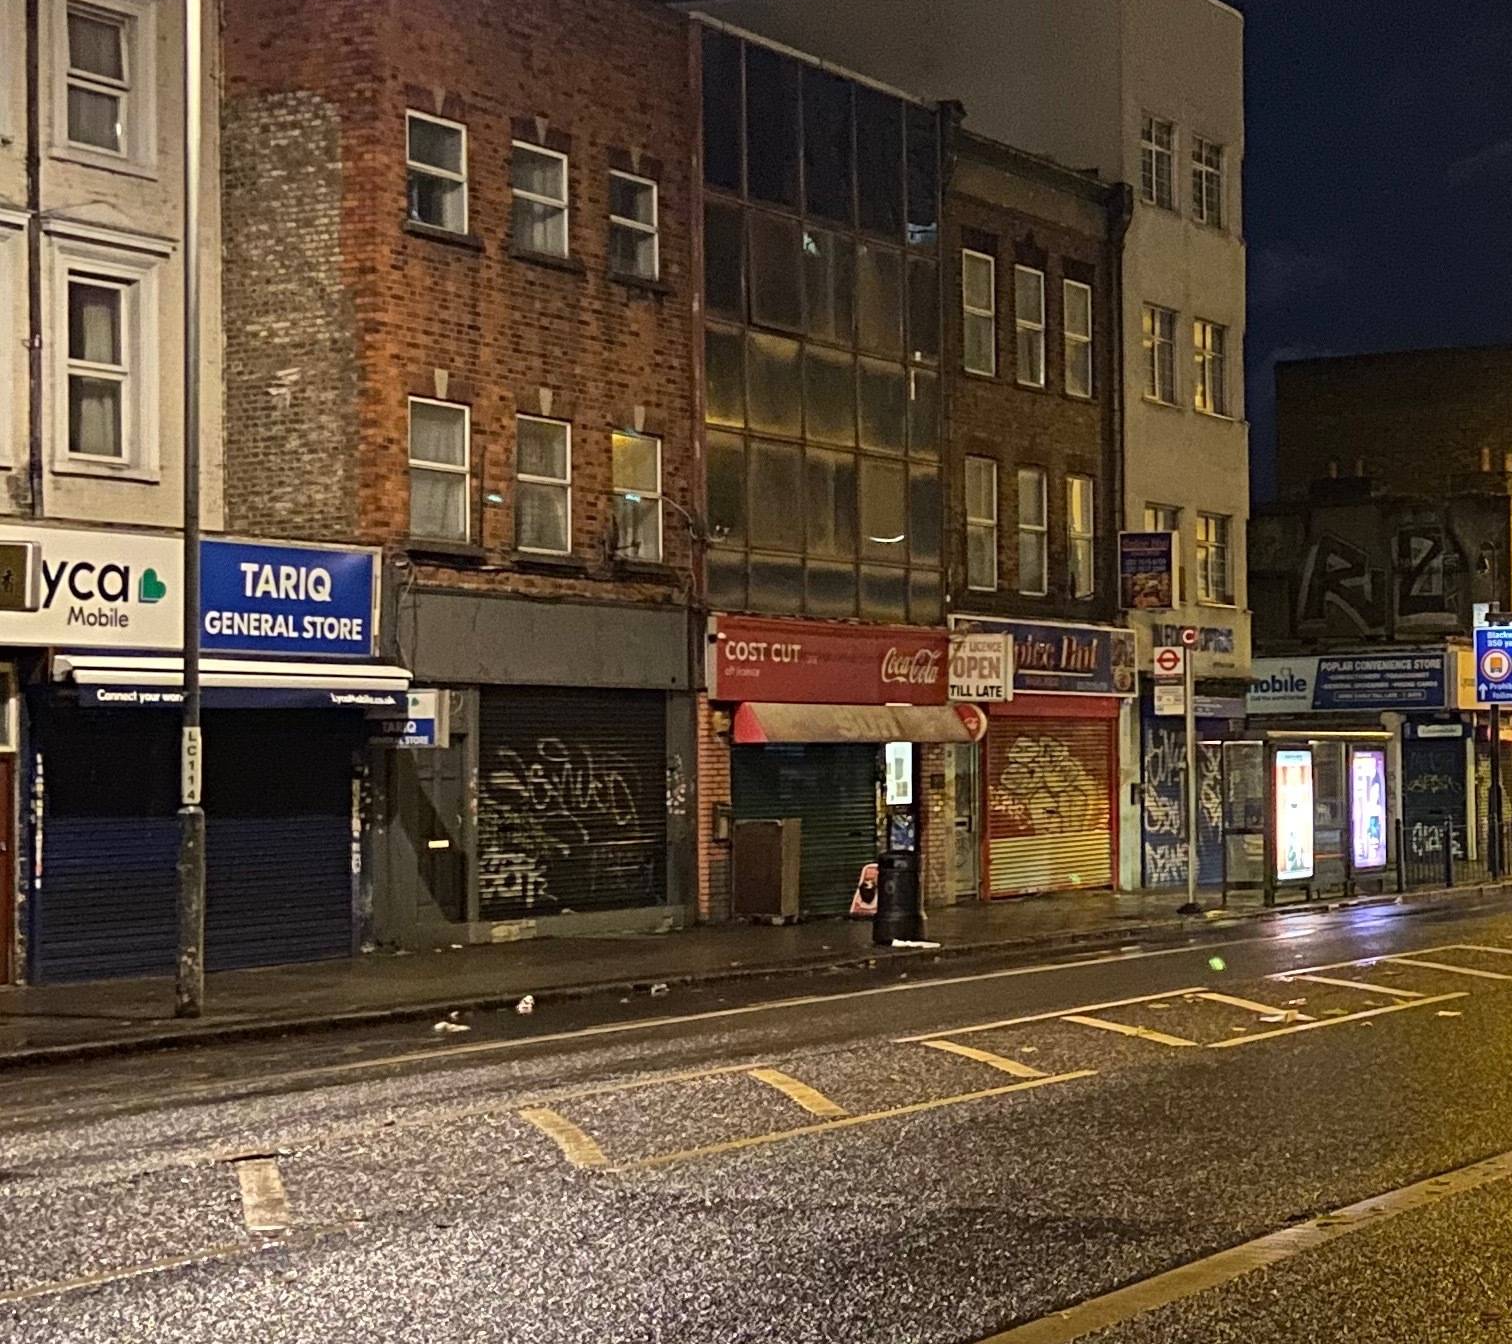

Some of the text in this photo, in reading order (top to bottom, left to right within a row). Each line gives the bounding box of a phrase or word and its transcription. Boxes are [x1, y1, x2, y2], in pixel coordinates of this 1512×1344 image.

[42, 559, 130, 609] yca
[240, 562, 332, 602] TARIQ
[67, 606, 129, 627] Mobile
[204, 610, 363, 641] GENERAL STORE
[1182, 629, 1196, 644] C
[725, 641, 767, 662] COST
[771, 643, 802, 663] CUT
[953, 656, 1001, 679] OPEN
[1414, 659, 1441, 670] STORE
[950, 685, 1003, 698] TILL LATE
[187, 731, 197, 800] LC114
